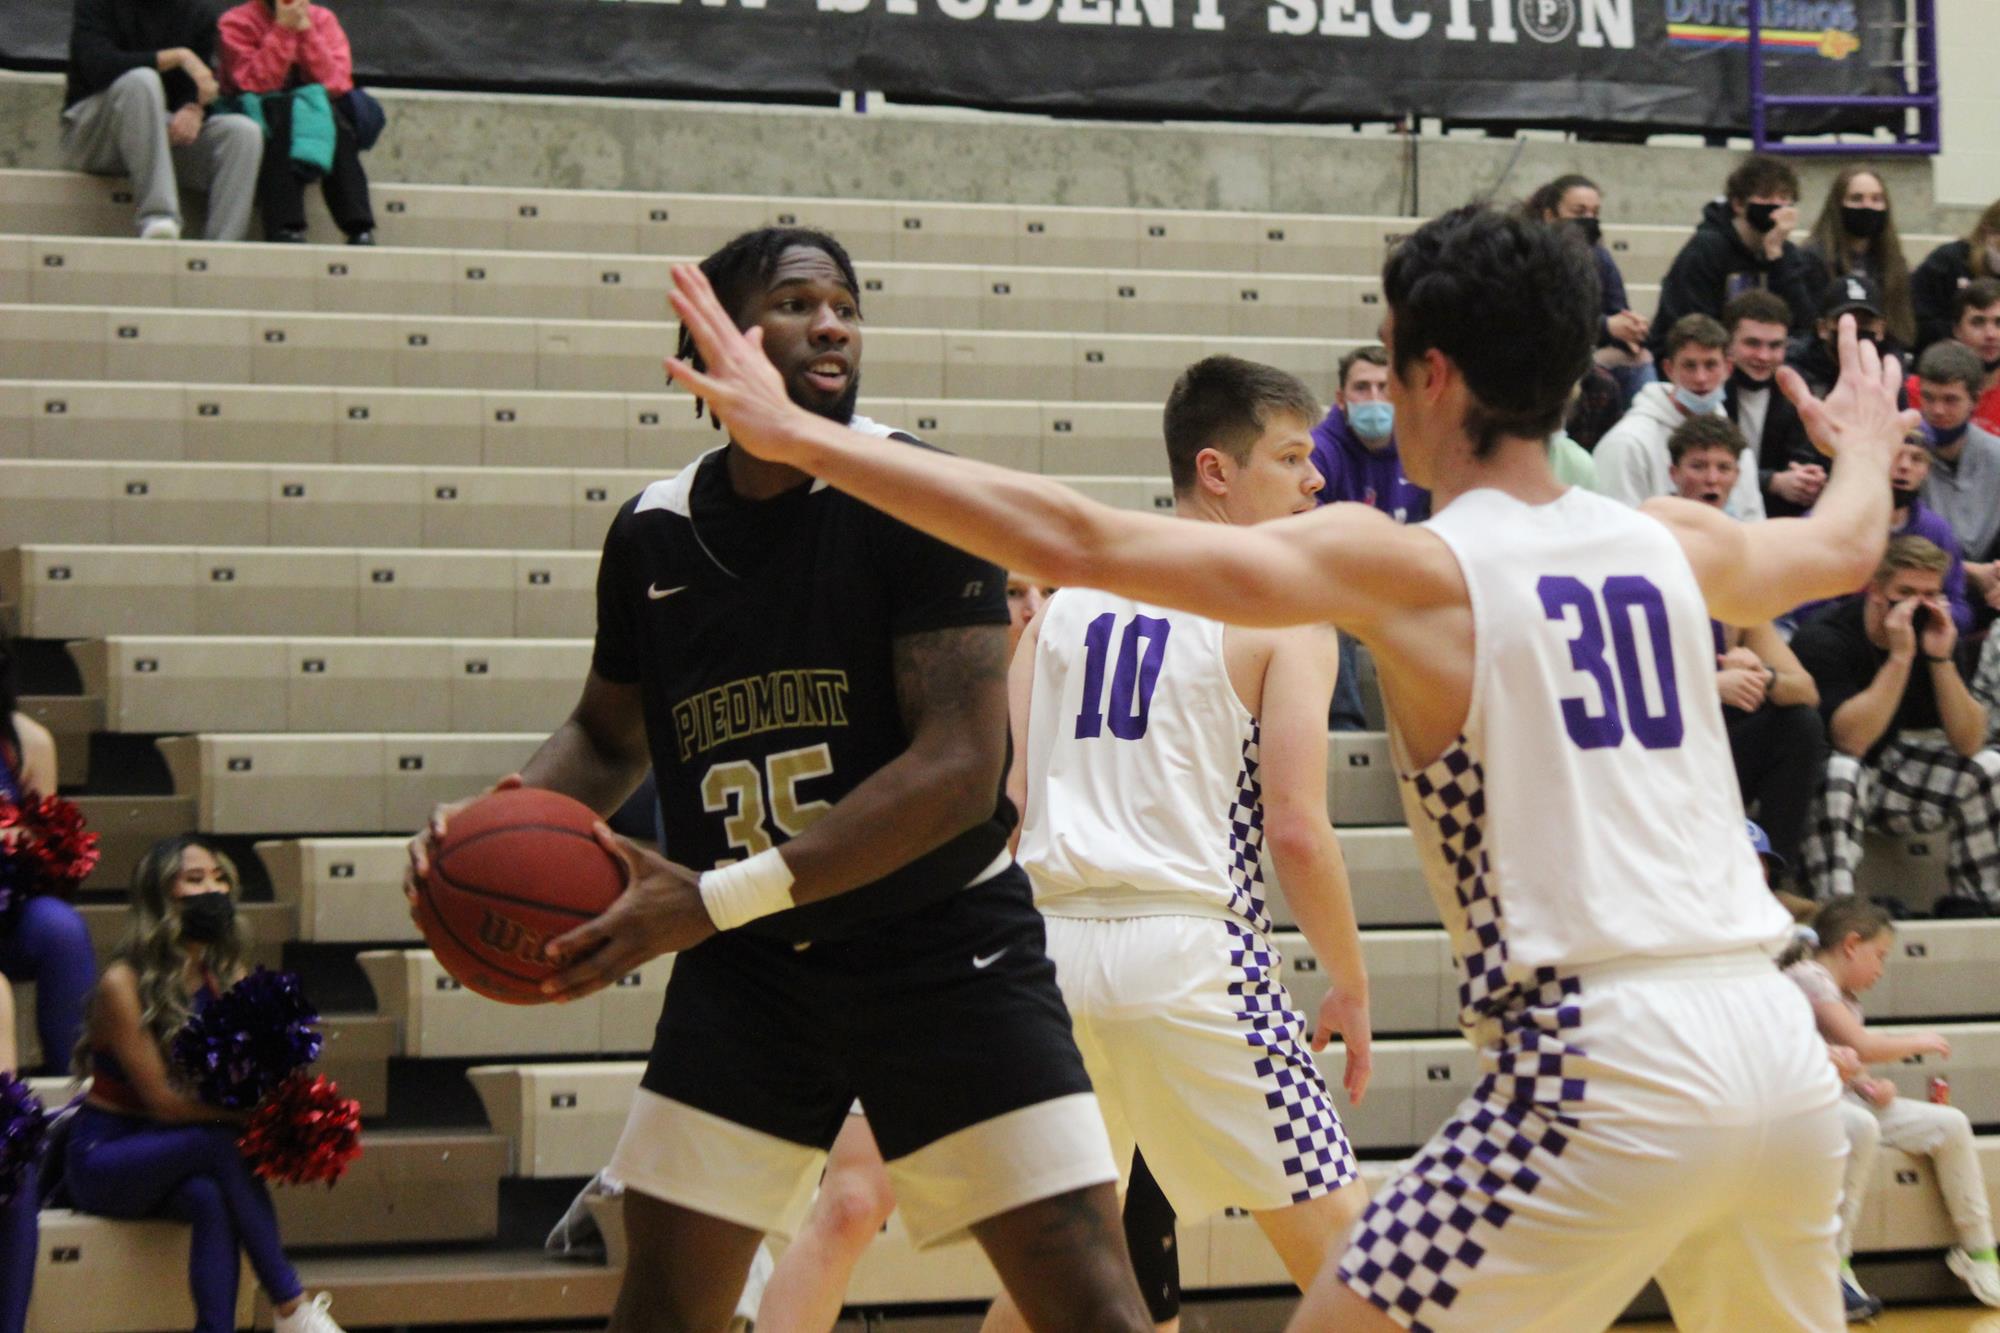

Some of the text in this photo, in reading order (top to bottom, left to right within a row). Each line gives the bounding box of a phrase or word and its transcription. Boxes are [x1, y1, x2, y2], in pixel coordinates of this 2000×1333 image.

[671, 669, 850, 763] PIEDMONT
[1074, 612, 1171, 741] 10
[1537, 575, 1683, 750] 30
[701, 742, 834, 871] 35
